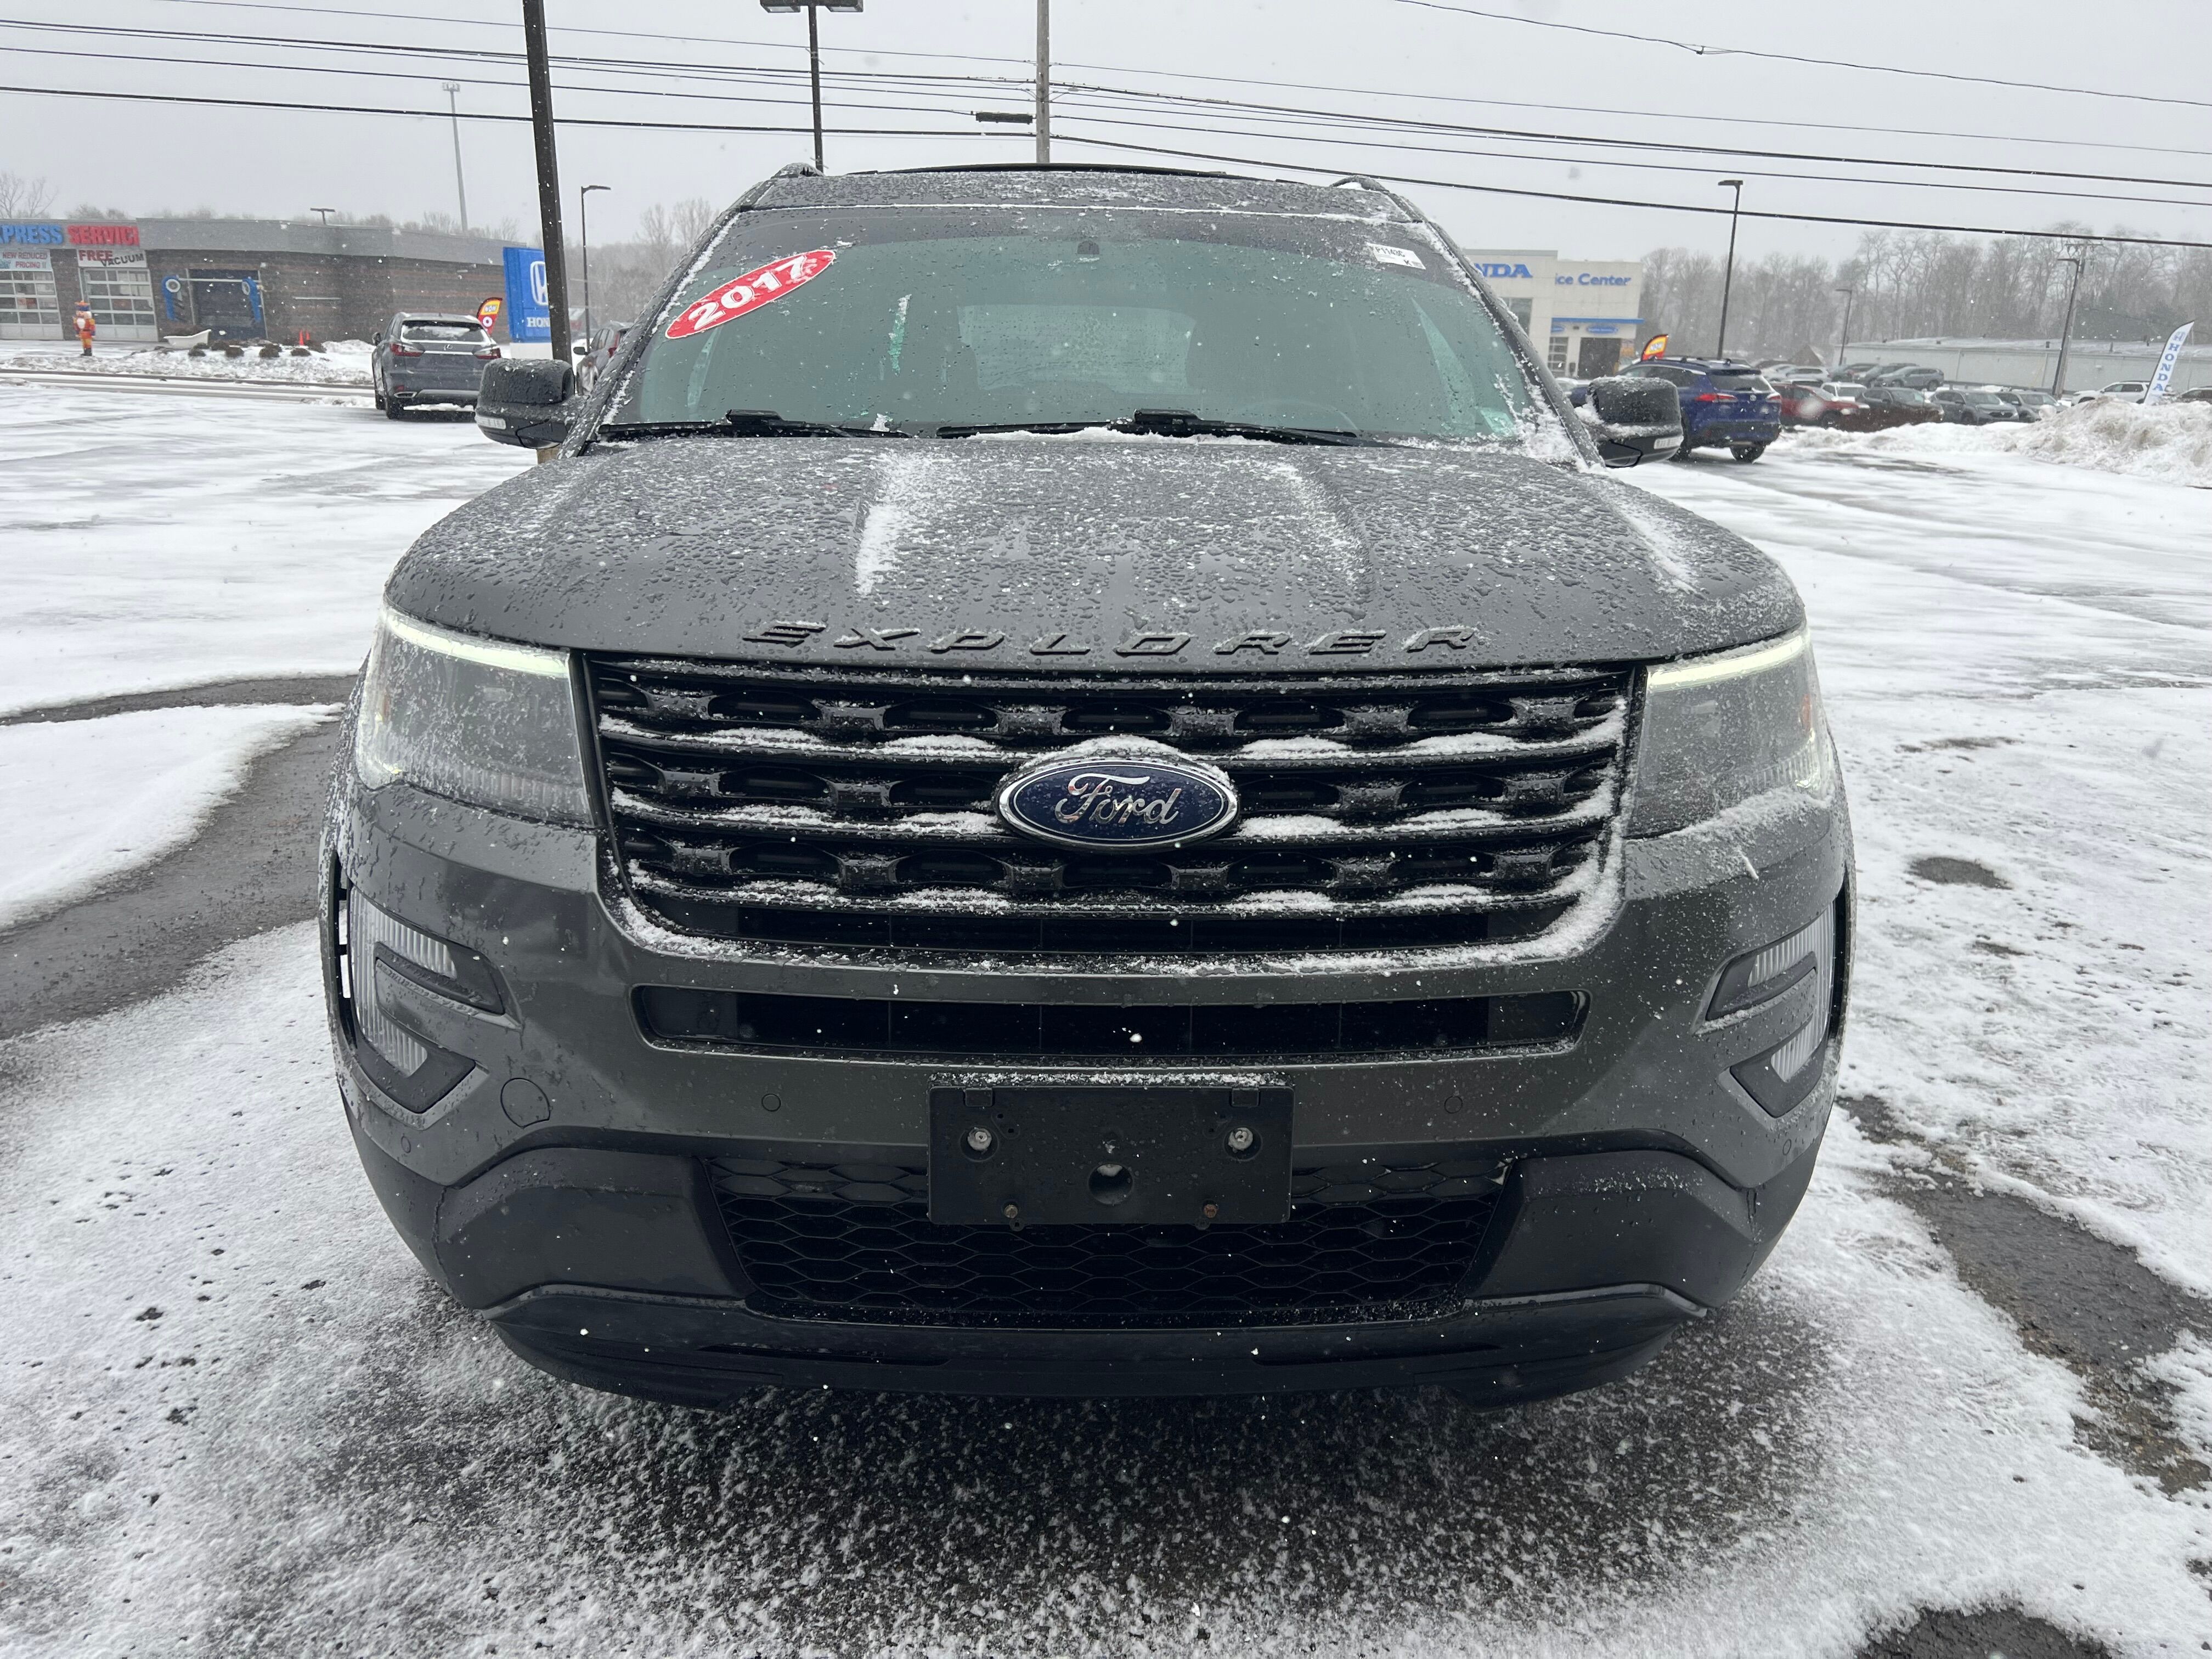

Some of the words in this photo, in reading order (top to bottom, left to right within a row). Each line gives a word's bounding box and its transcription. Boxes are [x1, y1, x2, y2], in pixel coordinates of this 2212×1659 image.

[0, 224, 63, 244] PRESS
[78, 250, 112, 261] FREE
[101, 253, 144, 267] VACUUM
[1474, 263, 1533, 278] NDA
[1578, 273, 1632, 286] Center
[688, 255, 807, 330] 2017
[526, 317, 550, 328] HON
[2151, 343, 2180, 391] HONDA
[742, 619, 1480, 657] EXPLORER
[1054, 772, 1182, 824] Ford
